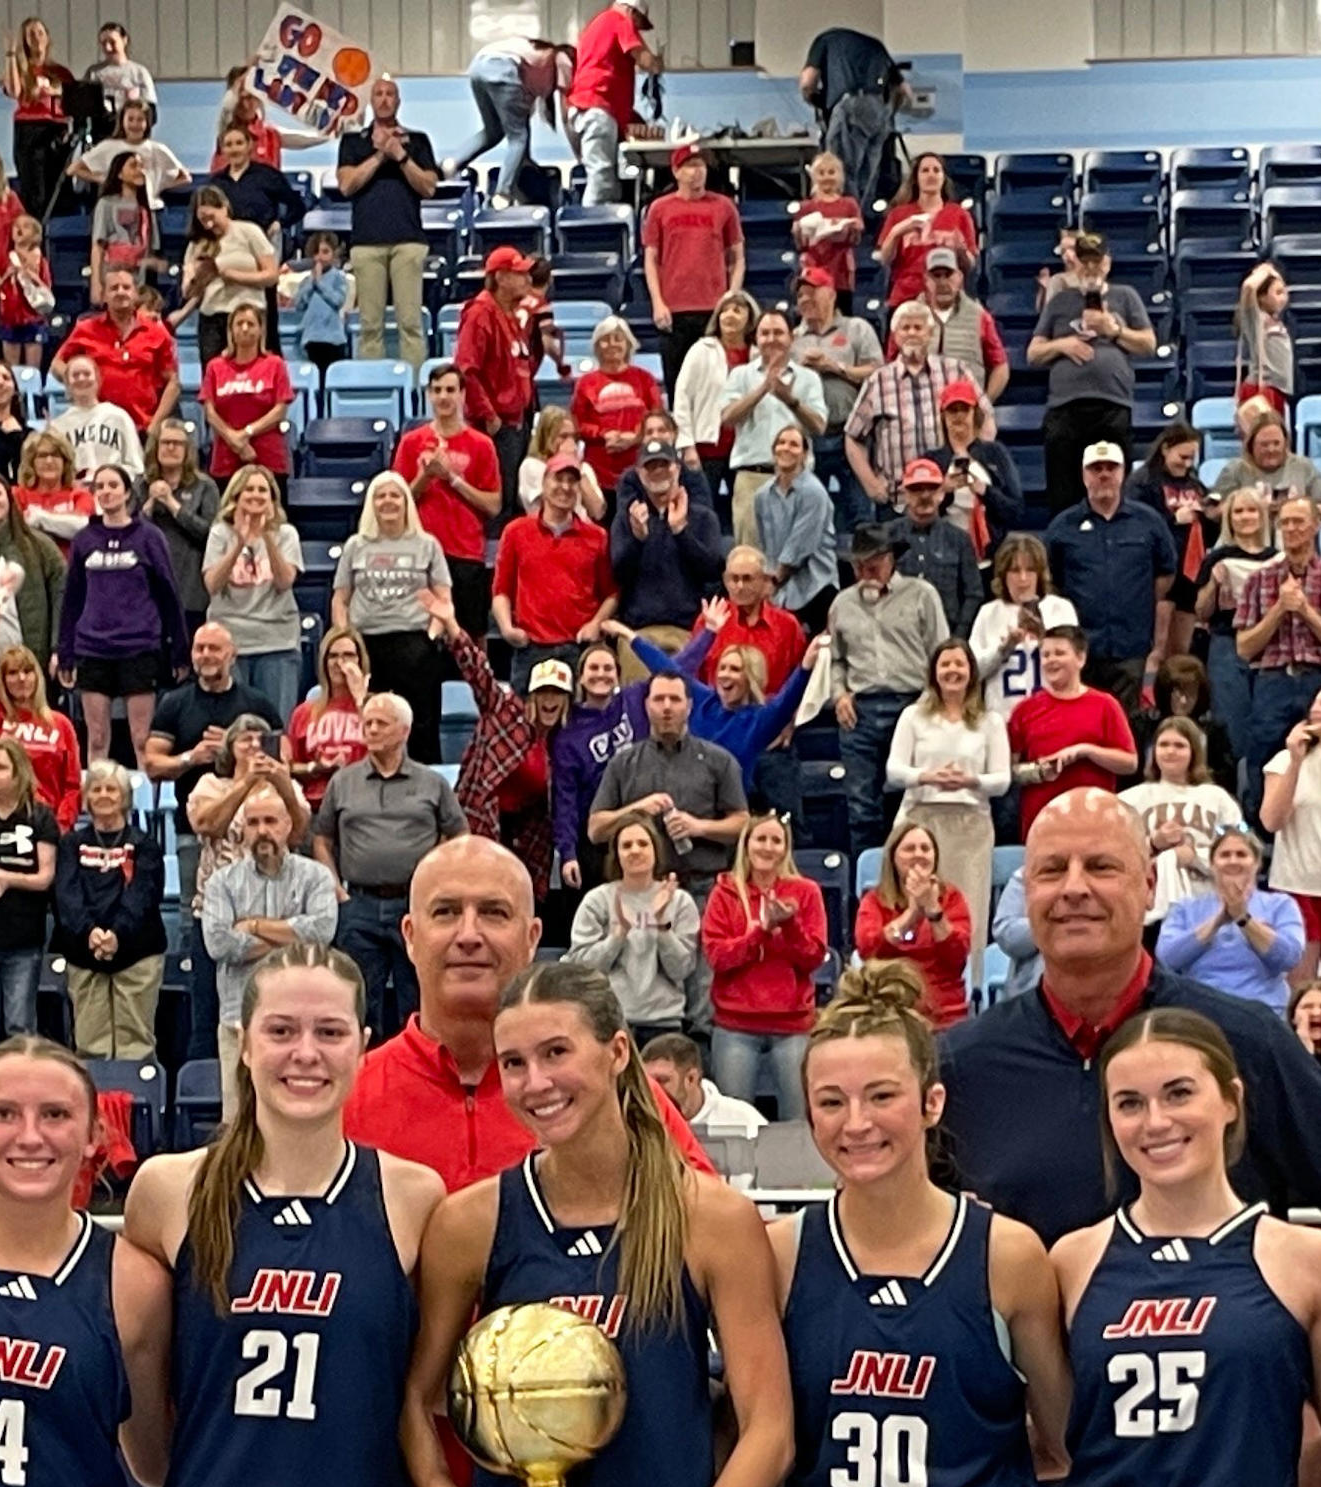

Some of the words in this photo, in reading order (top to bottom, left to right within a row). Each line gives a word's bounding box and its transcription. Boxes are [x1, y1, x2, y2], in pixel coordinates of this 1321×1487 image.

[279, 14, 322, 57] GO
[1002, 647, 1042, 697] 21
[230, 1268, 342, 1317] JNLI
[549, 1294, 629, 1339] LI
[1102, 1296, 1217, 1339] JNLI
[234, 1329, 320, 1420] 21
[830, 1350, 937, 1400] JNLI
[1107, 1351, 1207, 1438] 25
